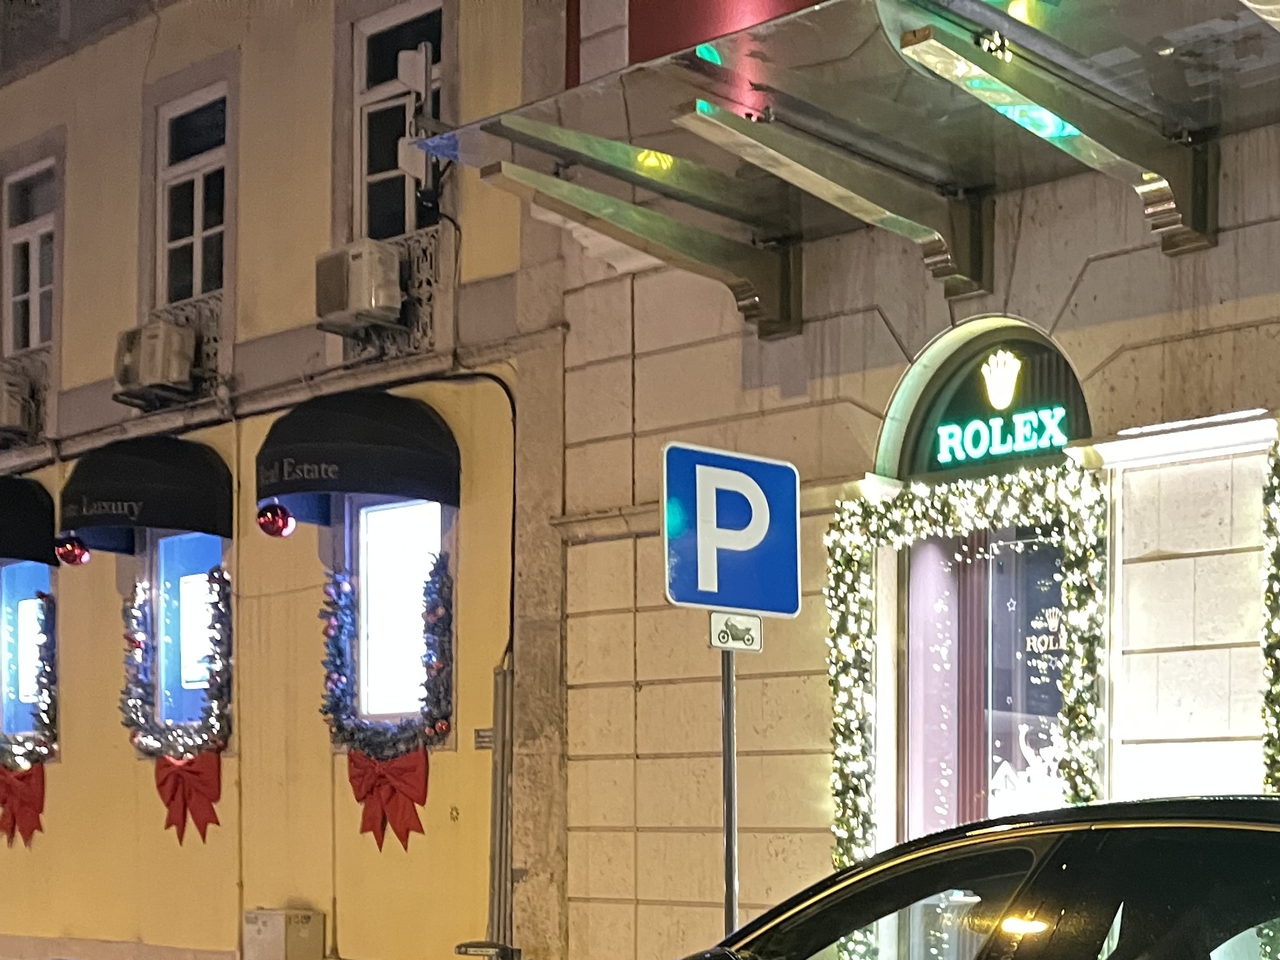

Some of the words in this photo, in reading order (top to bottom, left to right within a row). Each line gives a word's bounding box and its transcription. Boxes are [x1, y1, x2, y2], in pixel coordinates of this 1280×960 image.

[937, 406, 1068, 463] ROLEX
[283, 458, 339, 481] Estate
[81, 495, 144, 521] Luxury
[696, 464, 770, 592] P
[1025, 634, 1068, 653] ROL
